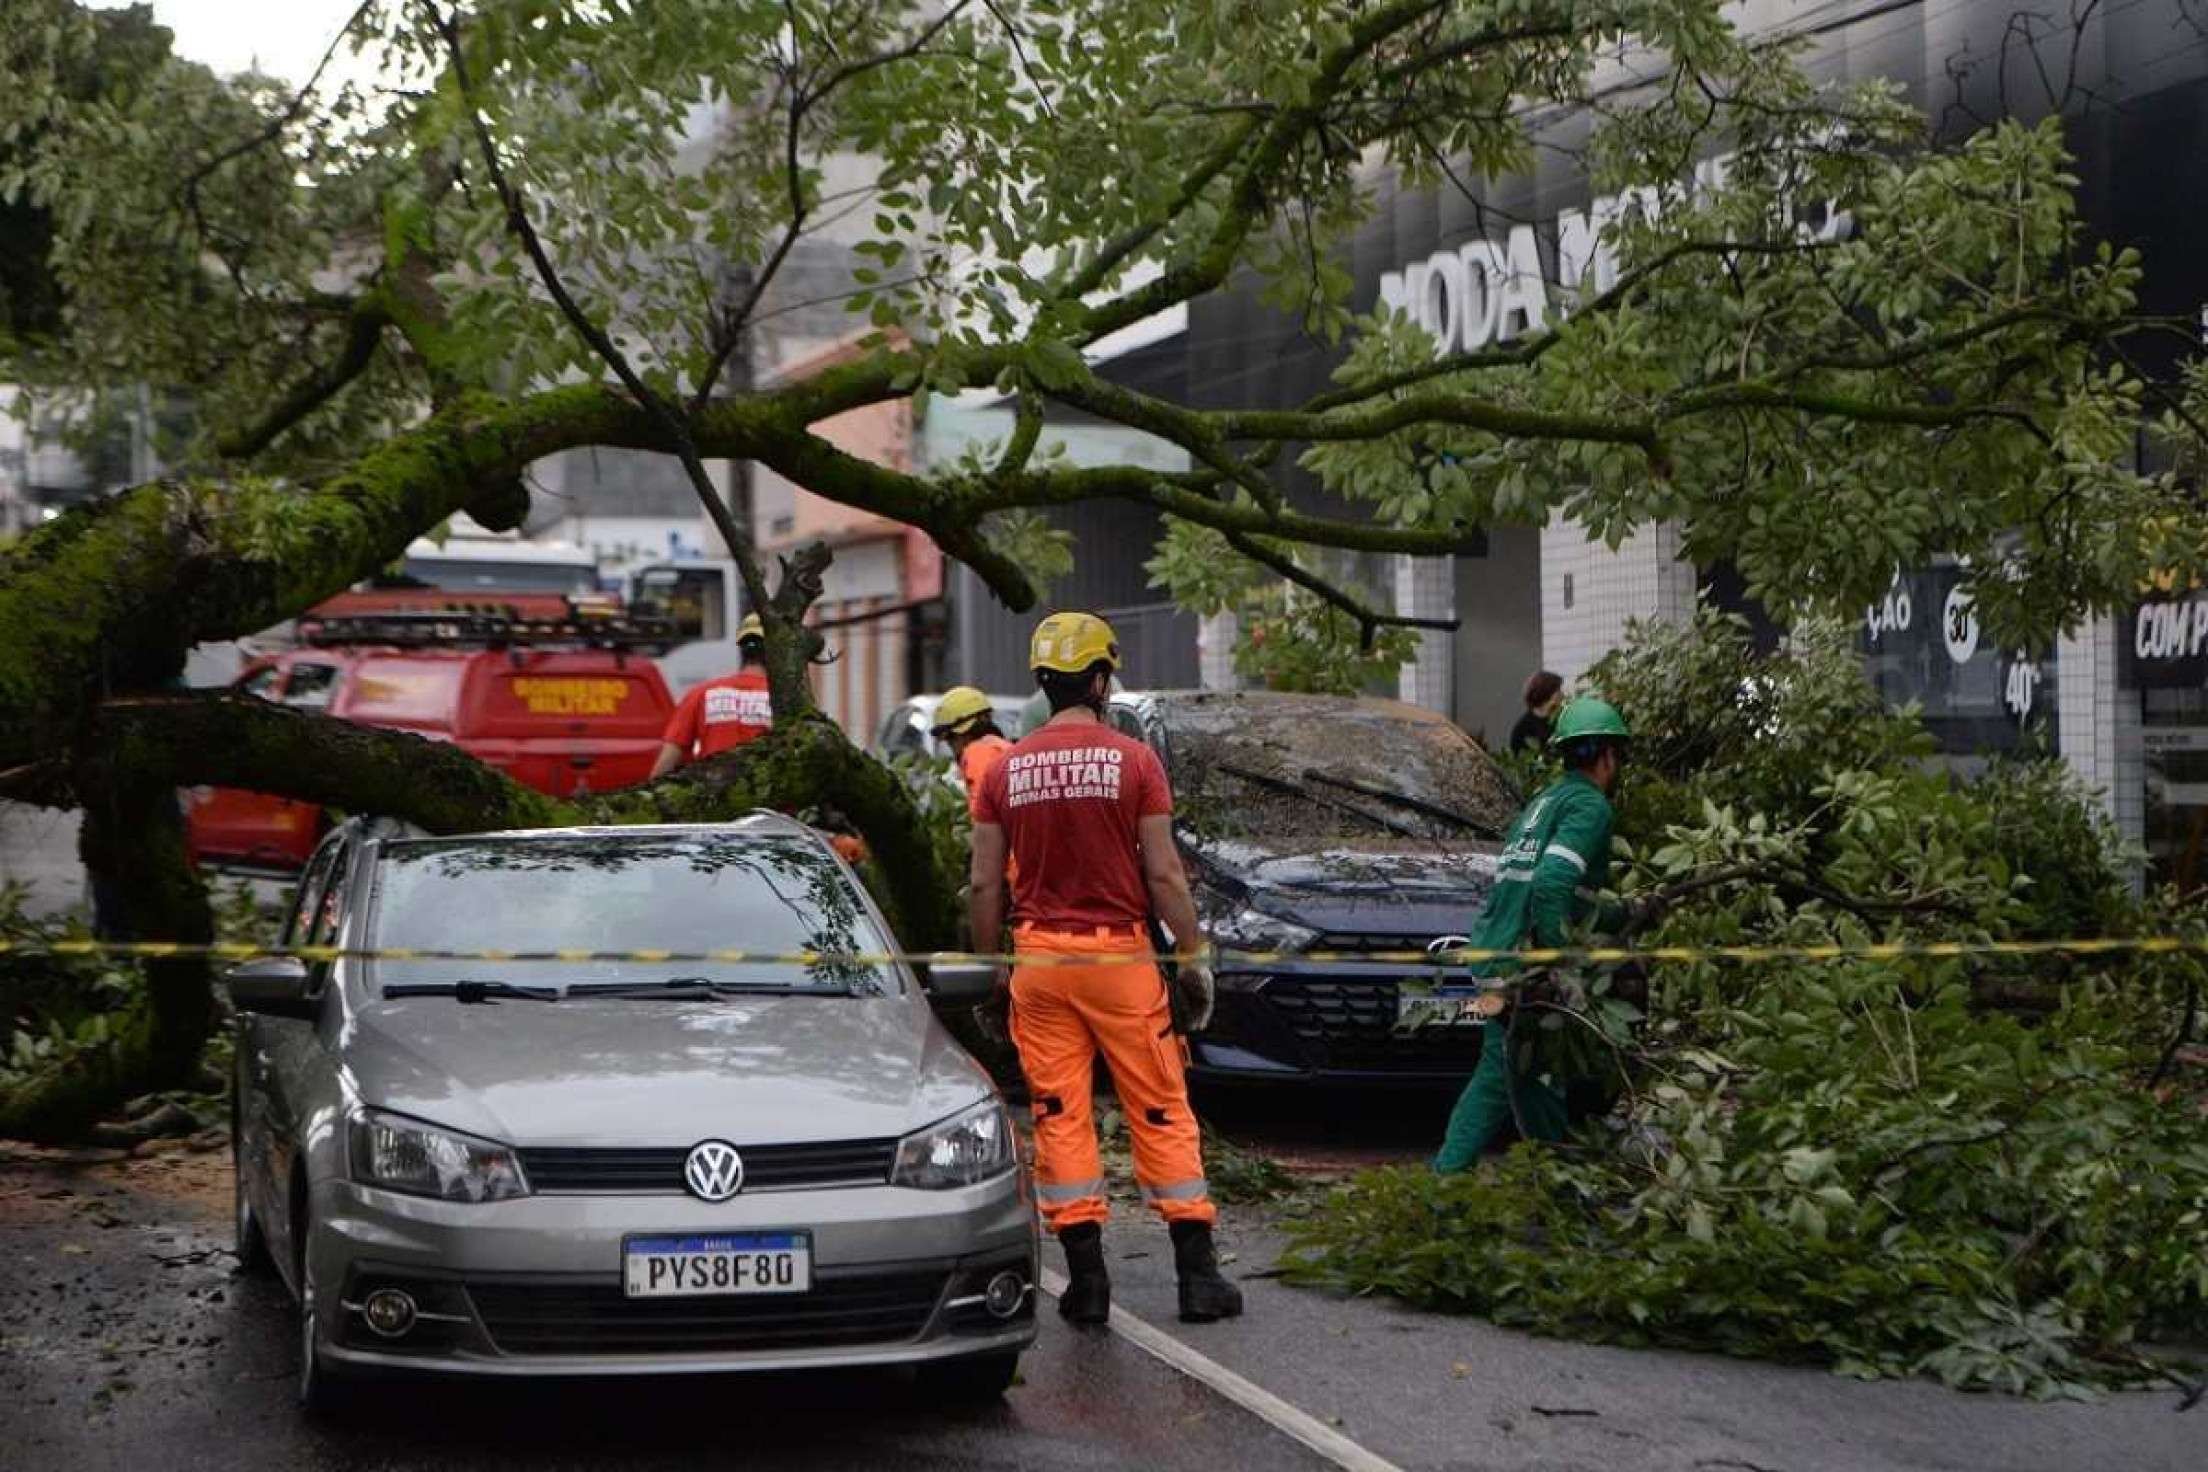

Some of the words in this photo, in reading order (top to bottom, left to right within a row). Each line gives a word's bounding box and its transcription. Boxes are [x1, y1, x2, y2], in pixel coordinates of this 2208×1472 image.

[1009, 747, 1121, 772] BOMBEIRO
[1009, 763, 1120, 794] MILITAR
[1009, 788, 1060, 807] MINAS
[648, 1254, 793, 1288] PYS8F80
